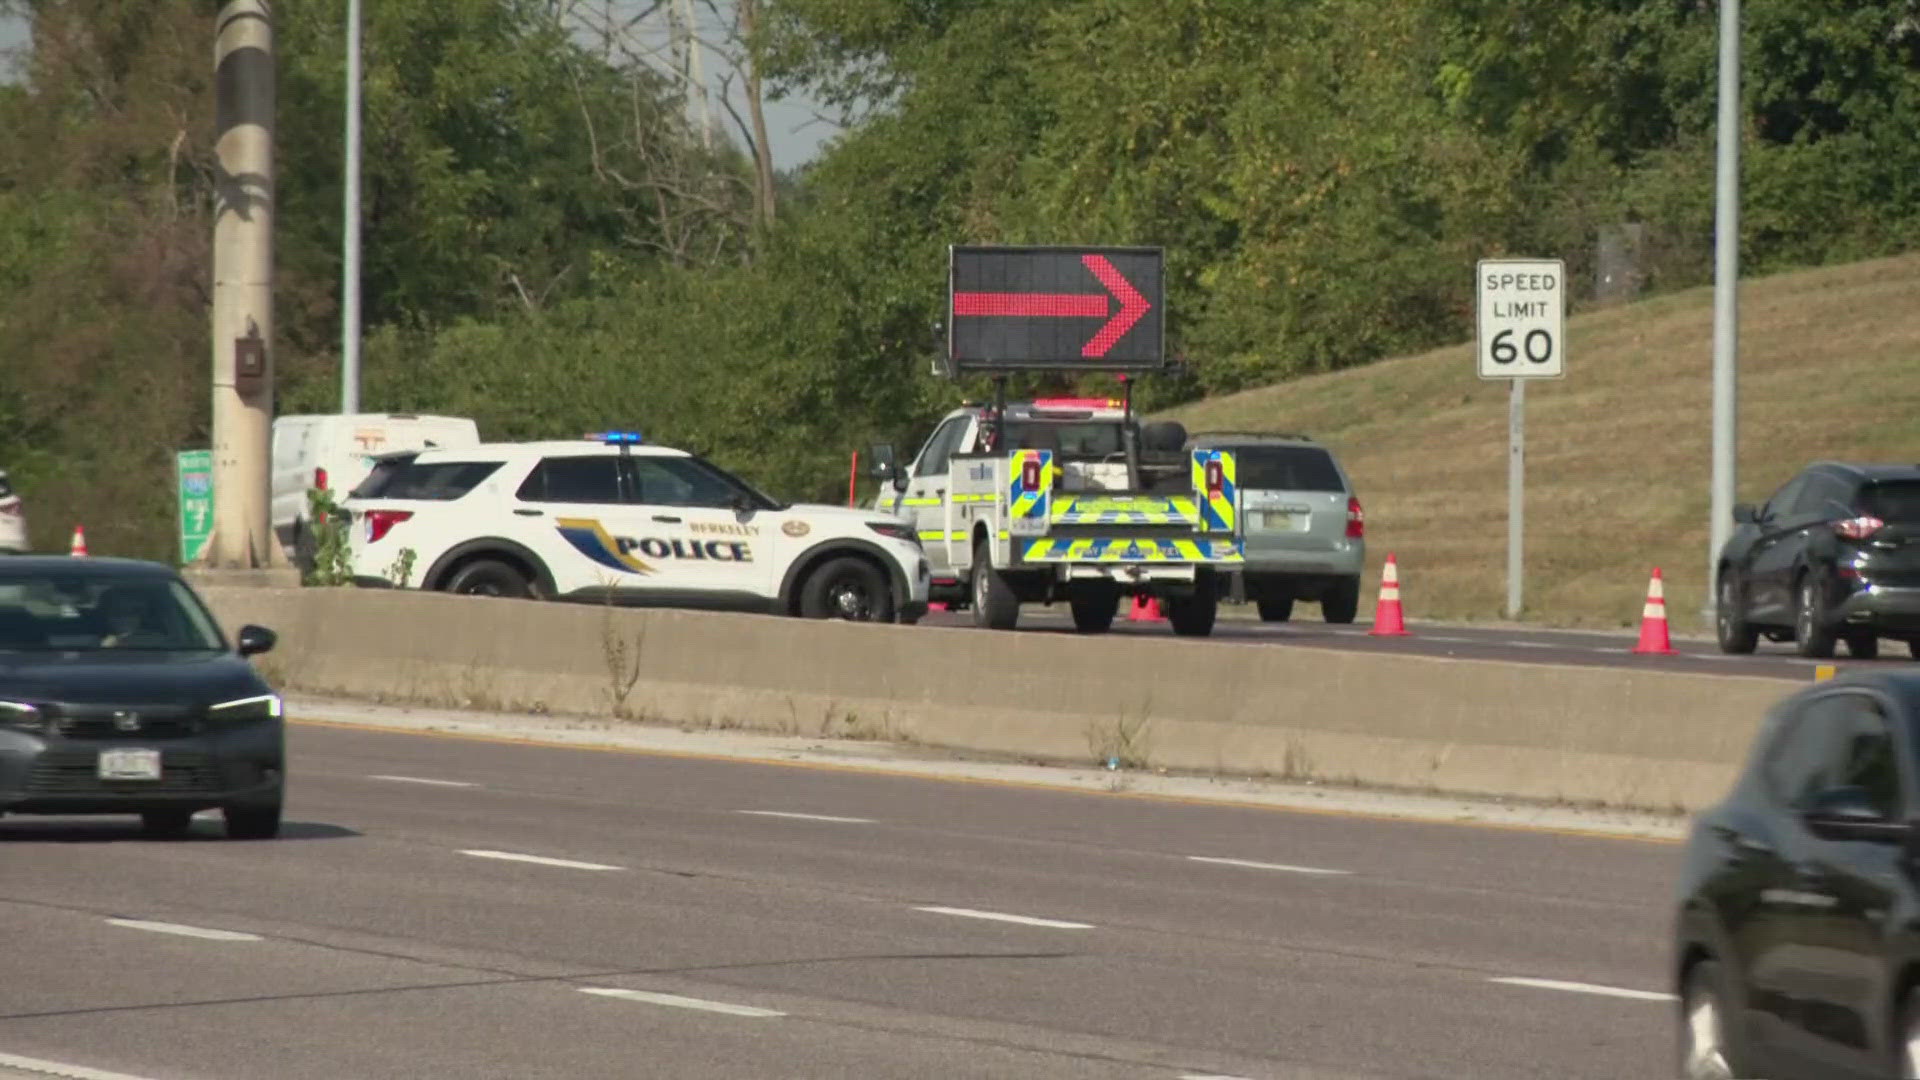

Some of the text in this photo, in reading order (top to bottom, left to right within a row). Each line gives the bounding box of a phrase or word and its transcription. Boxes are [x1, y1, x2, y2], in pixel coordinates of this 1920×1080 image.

[1487, 273, 1555, 291] SPEED
[1494, 302, 1547, 317] LIMIT
[1491, 328, 1551, 364] 60
[616, 537, 753, 562] POLICE
